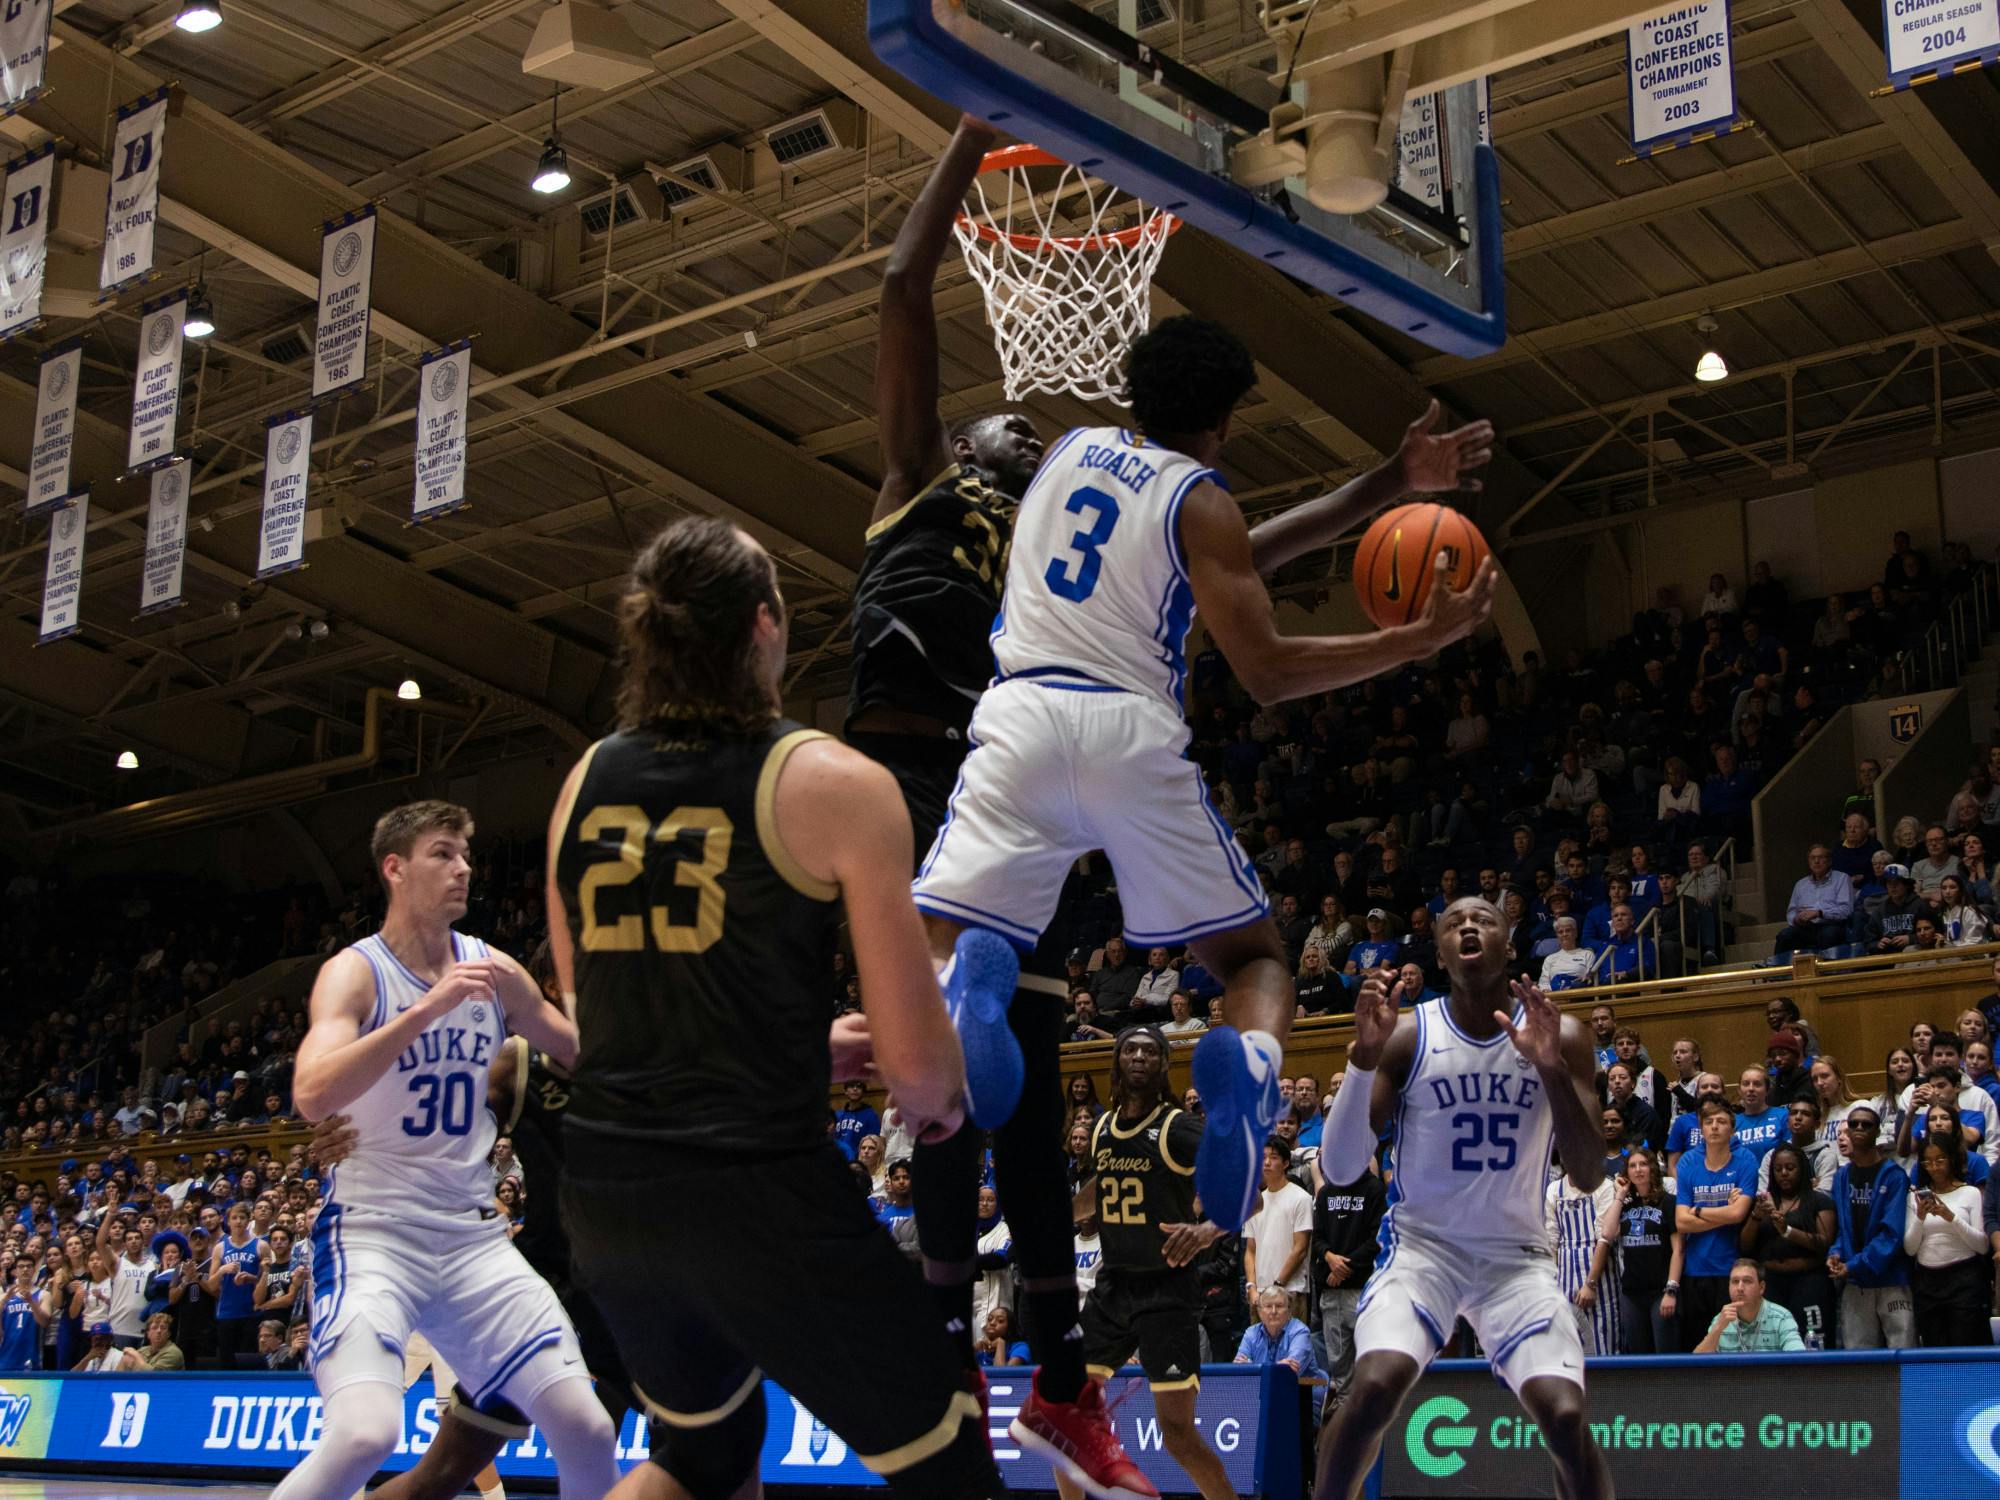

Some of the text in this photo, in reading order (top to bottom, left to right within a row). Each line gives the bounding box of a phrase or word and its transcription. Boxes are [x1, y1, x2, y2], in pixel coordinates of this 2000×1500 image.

[1903, 13, 1944, 32] REGULAR
[1946, 2, 1982, 20] SEASON
[1654, 20, 1699, 45] COAST
[1922, 27, 1966, 53] 2004
[1635, 32, 1725, 72] CONFERENCE
[1640, 52, 1722, 90] CHAMPIONS
[1653, 77, 1708, 100] TOURNAMENT
[1664, 100, 1700, 122] 2003
[327, 282, 361, 306] ATLANTIC
[331, 300, 355, 319] COAST
[318, 309, 366, 339] CONFERENCE
[318, 326, 362, 353] CHAMPIONS
[143, 361, 173, 383] ATLANTIC
[328, 364, 349, 382] 1963
[146, 378, 167, 396] COAST
[134, 388, 177, 413] CONFERENCE
[42, 407, 69, 427] ATLANTIC
[134, 403, 174, 427] CHAMPIONS
[44, 423, 63, 439] COAST
[430, 425, 452, 443] COAST
[33, 433, 73, 457] CONFERENCE
[143, 438, 161, 454] 1960
[34, 447, 69, 470] CHAMPIONS
[1078, 445, 1157, 494] ROACH
[270, 473, 301, 491] ATLANTIC
[428, 485, 447, 501] 2001
[273, 488, 295, 503] COAST
[265, 498, 305, 521] CONFERENCE
[265, 512, 301, 533] CHAMPIONS
[53, 546, 77, 562] ATLANTIC
[270, 545, 289, 560] 2000
[1044, 486, 1120, 604] 3
[55, 559, 72, 574] COAST
[145, 552, 181, 572] CHAMPIONS
[47, 569, 80, 589] CONFERENCE
[47, 582, 78, 600] CHAMPIONS
[1894, 717, 1917, 736] 14
[579, 804, 734, 954] 23
[1429, 1072, 1539, 1110] DUKE
[402, 1071, 475, 1137] 30
[1452, 1112, 1519, 1172] 25
[1096, 1148, 1151, 1173] Braves
[1101, 1177, 1147, 1225] 22
[225, 1252, 256, 1266] DUKE
[134, 1280, 141, 1294] 1
[267, 1272, 291, 1284] DUKE
[16, 1313, 24, 1329] 1
[1758, 1413, 1873, 1455] Group
